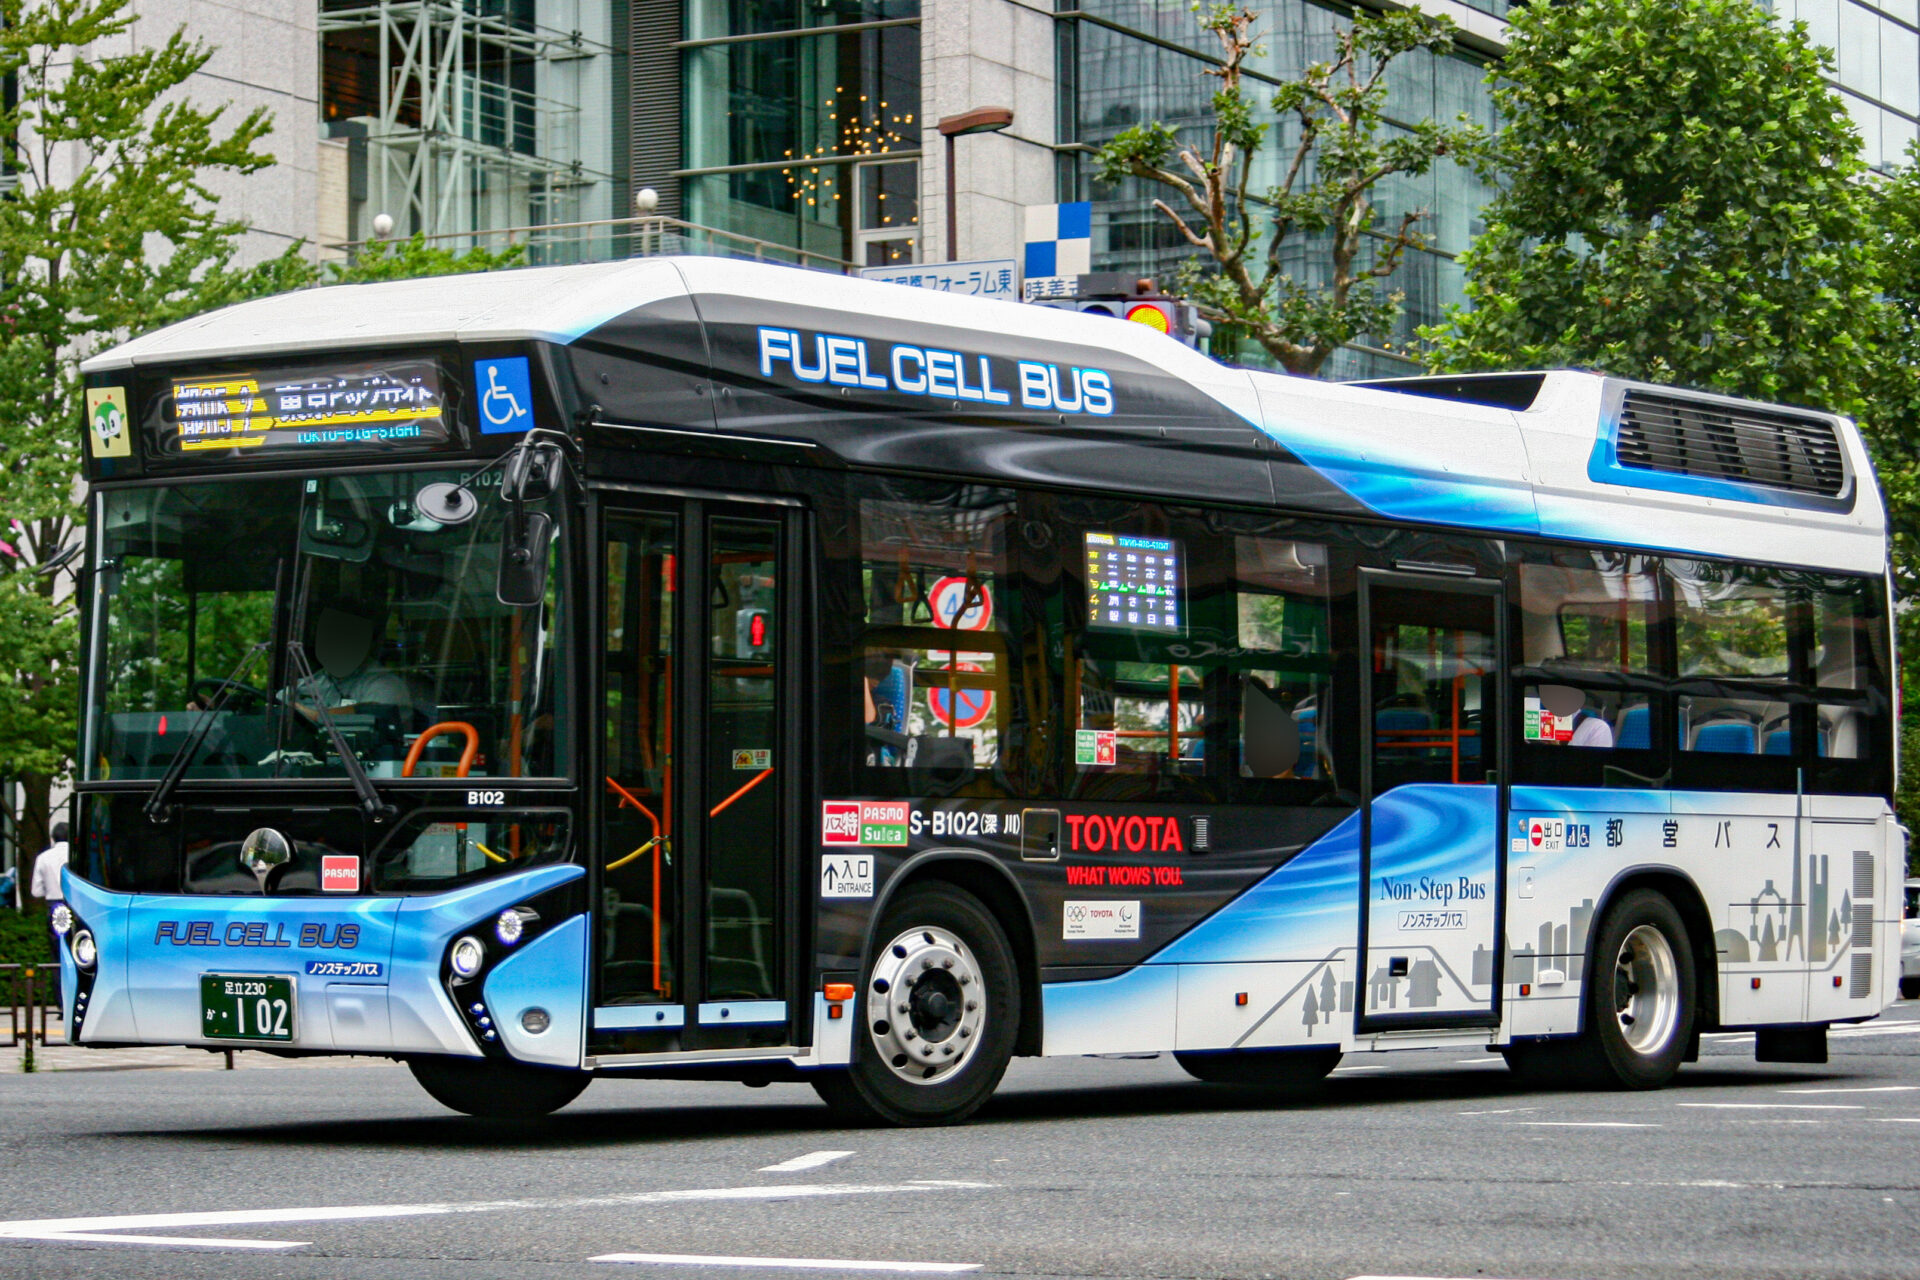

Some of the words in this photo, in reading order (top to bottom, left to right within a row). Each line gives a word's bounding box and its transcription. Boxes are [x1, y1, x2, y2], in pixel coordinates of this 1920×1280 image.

[758, 326, 888, 391] FUEL
[891, 343, 1011, 406] CELL
[1018, 360, 1115, 417] BUS
[468, 791, 504, 805] B102
[863, 807, 904, 820] PASMO
[864, 827, 902, 841] Suica
[1065, 814, 1184, 852] TOYOTA
[1543, 822, 1562, 838] 出口
[1606, 817, 1781, 849] 都営バス
[1546, 841, 1560, 849] EXIT
[324, 868, 357, 879] PASMO
[842, 860, 868, 879] 入口
[1066, 866, 1106, 886] WHAT
[1108, 866, 1152, 886] WOWS
[1153, 866, 1184, 886] YOU.
[838, 882, 872, 893] ENTRANCE
[1458, 876, 1486, 900] Bus
[1090, 910, 1113, 918] TOYOTA
[1402, 911, 1463, 928] ノンステップバス
[155, 921, 220, 946] FUEL
[224, 922, 291, 947] CELL
[298, 923, 360, 948] BUS
[309, 962, 378, 976] ノンステップバス
